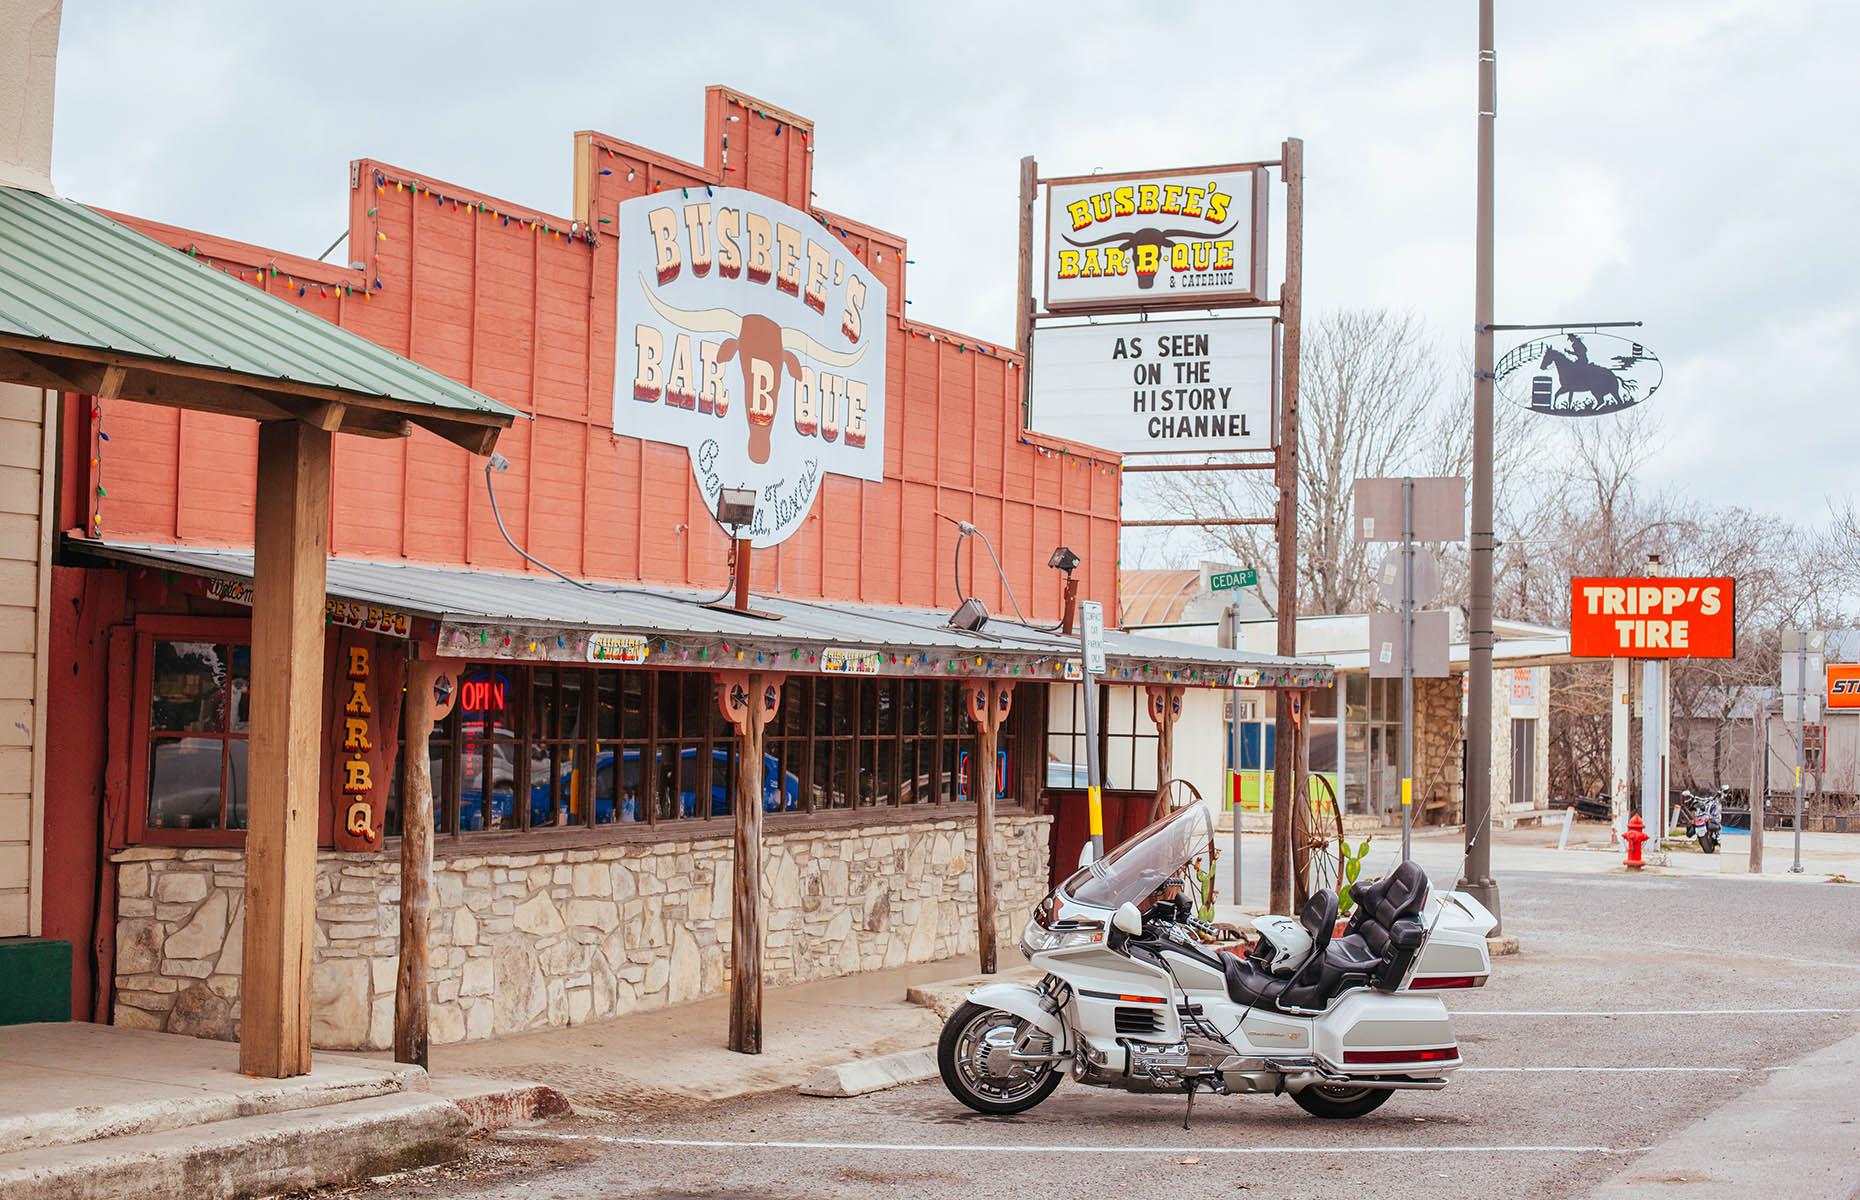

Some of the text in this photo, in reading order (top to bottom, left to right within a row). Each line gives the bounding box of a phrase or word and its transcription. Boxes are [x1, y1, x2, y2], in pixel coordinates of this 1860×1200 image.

[1066, 181, 1233, 233] BUSBEE'S
[648, 202, 867, 345] BUSBEE'S
[1169, 272, 1233, 288] & CATERING
[1112, 333, 1210, 361] AS SEEN
[1133, 361, 1211, 386] ON THE
[1133, 387, 1232, 413] HISTORY
[1147, 414, 1251, 440] CHANNEL
[1212, 572, 1248, 588] CEDAR
[1583, 586, 1721, 616] TRIPP'S
[1615, 620, 1689, 648] TIRE
[1831, 679, 1860, 694] ST
